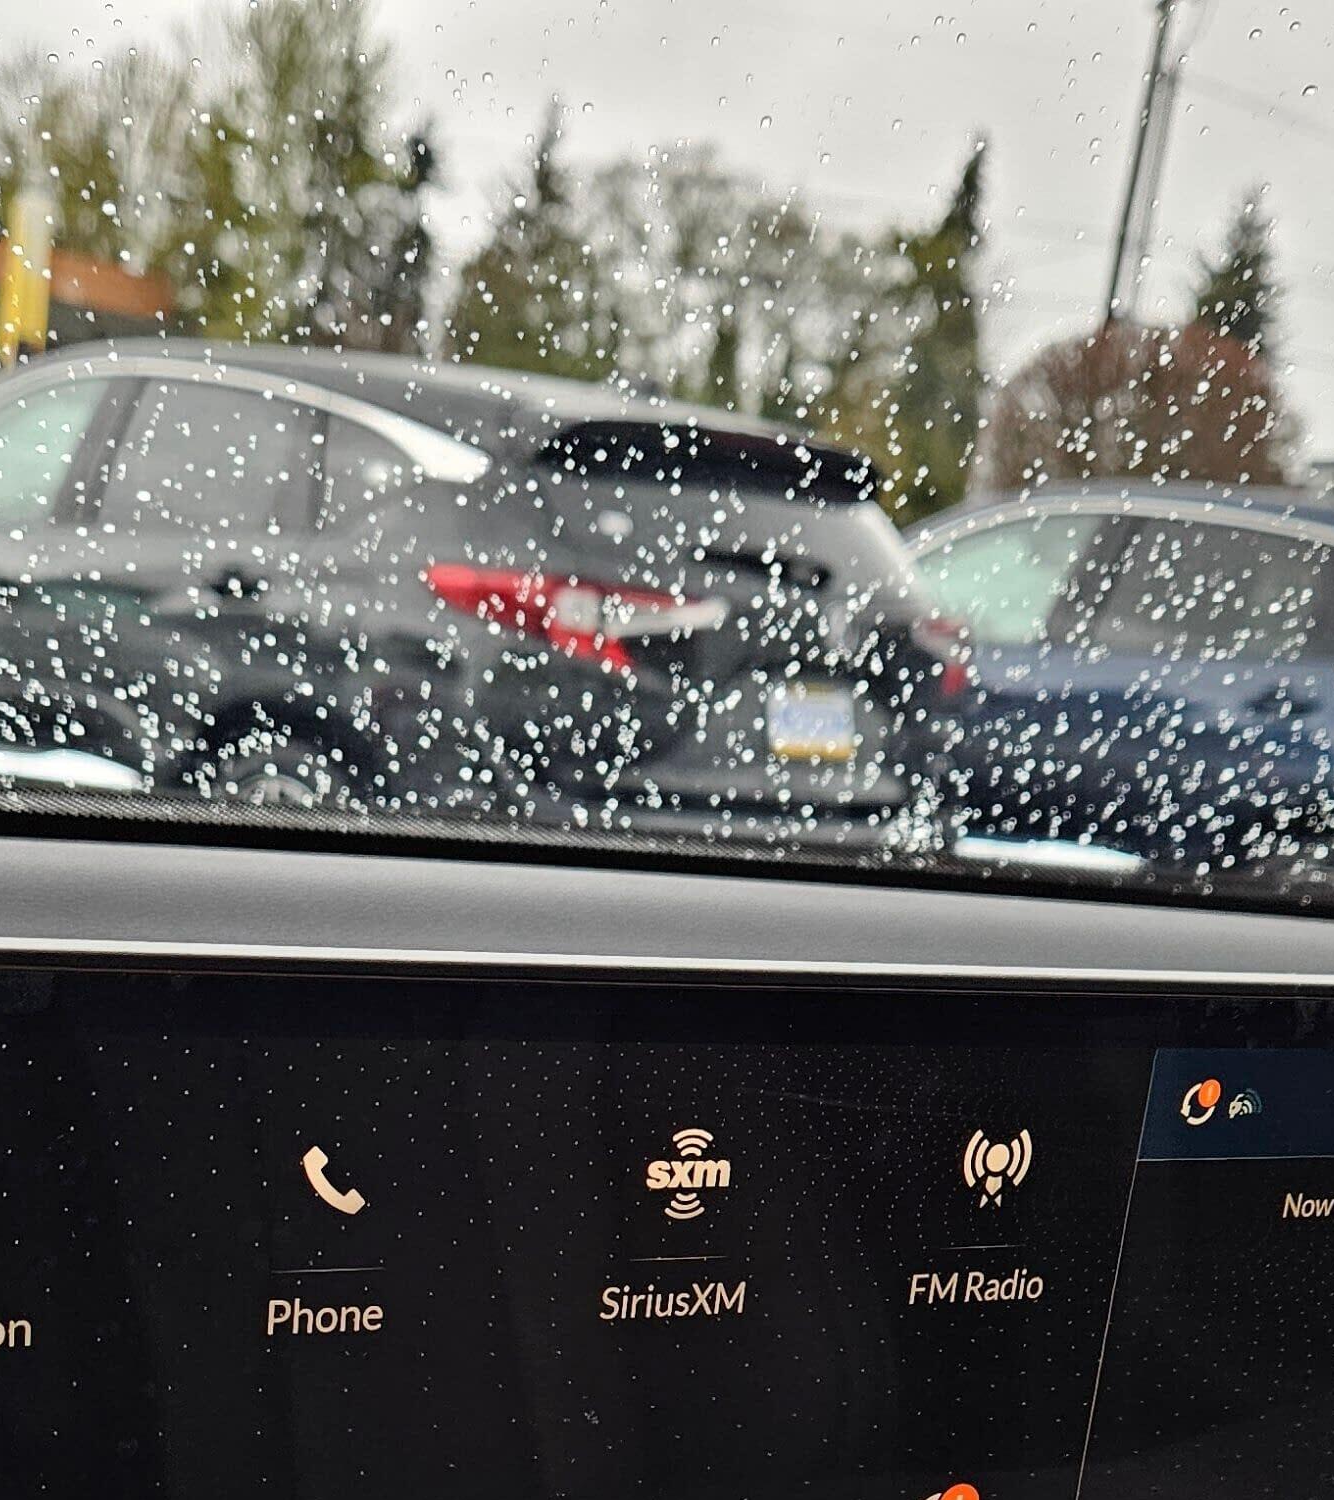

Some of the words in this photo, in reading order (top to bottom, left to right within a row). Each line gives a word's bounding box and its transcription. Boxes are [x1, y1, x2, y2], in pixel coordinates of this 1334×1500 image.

[646, 1160, 731, 1189] sxm
[1283, 1193, 1334, 1218] Now
[600, 1282, 746, 1319] SiriusXM
[909, 1273, 958, 1304] FM
[964, 1269, 1043, 1302] Radio
[268, 1298, 383, 1335] Phone
